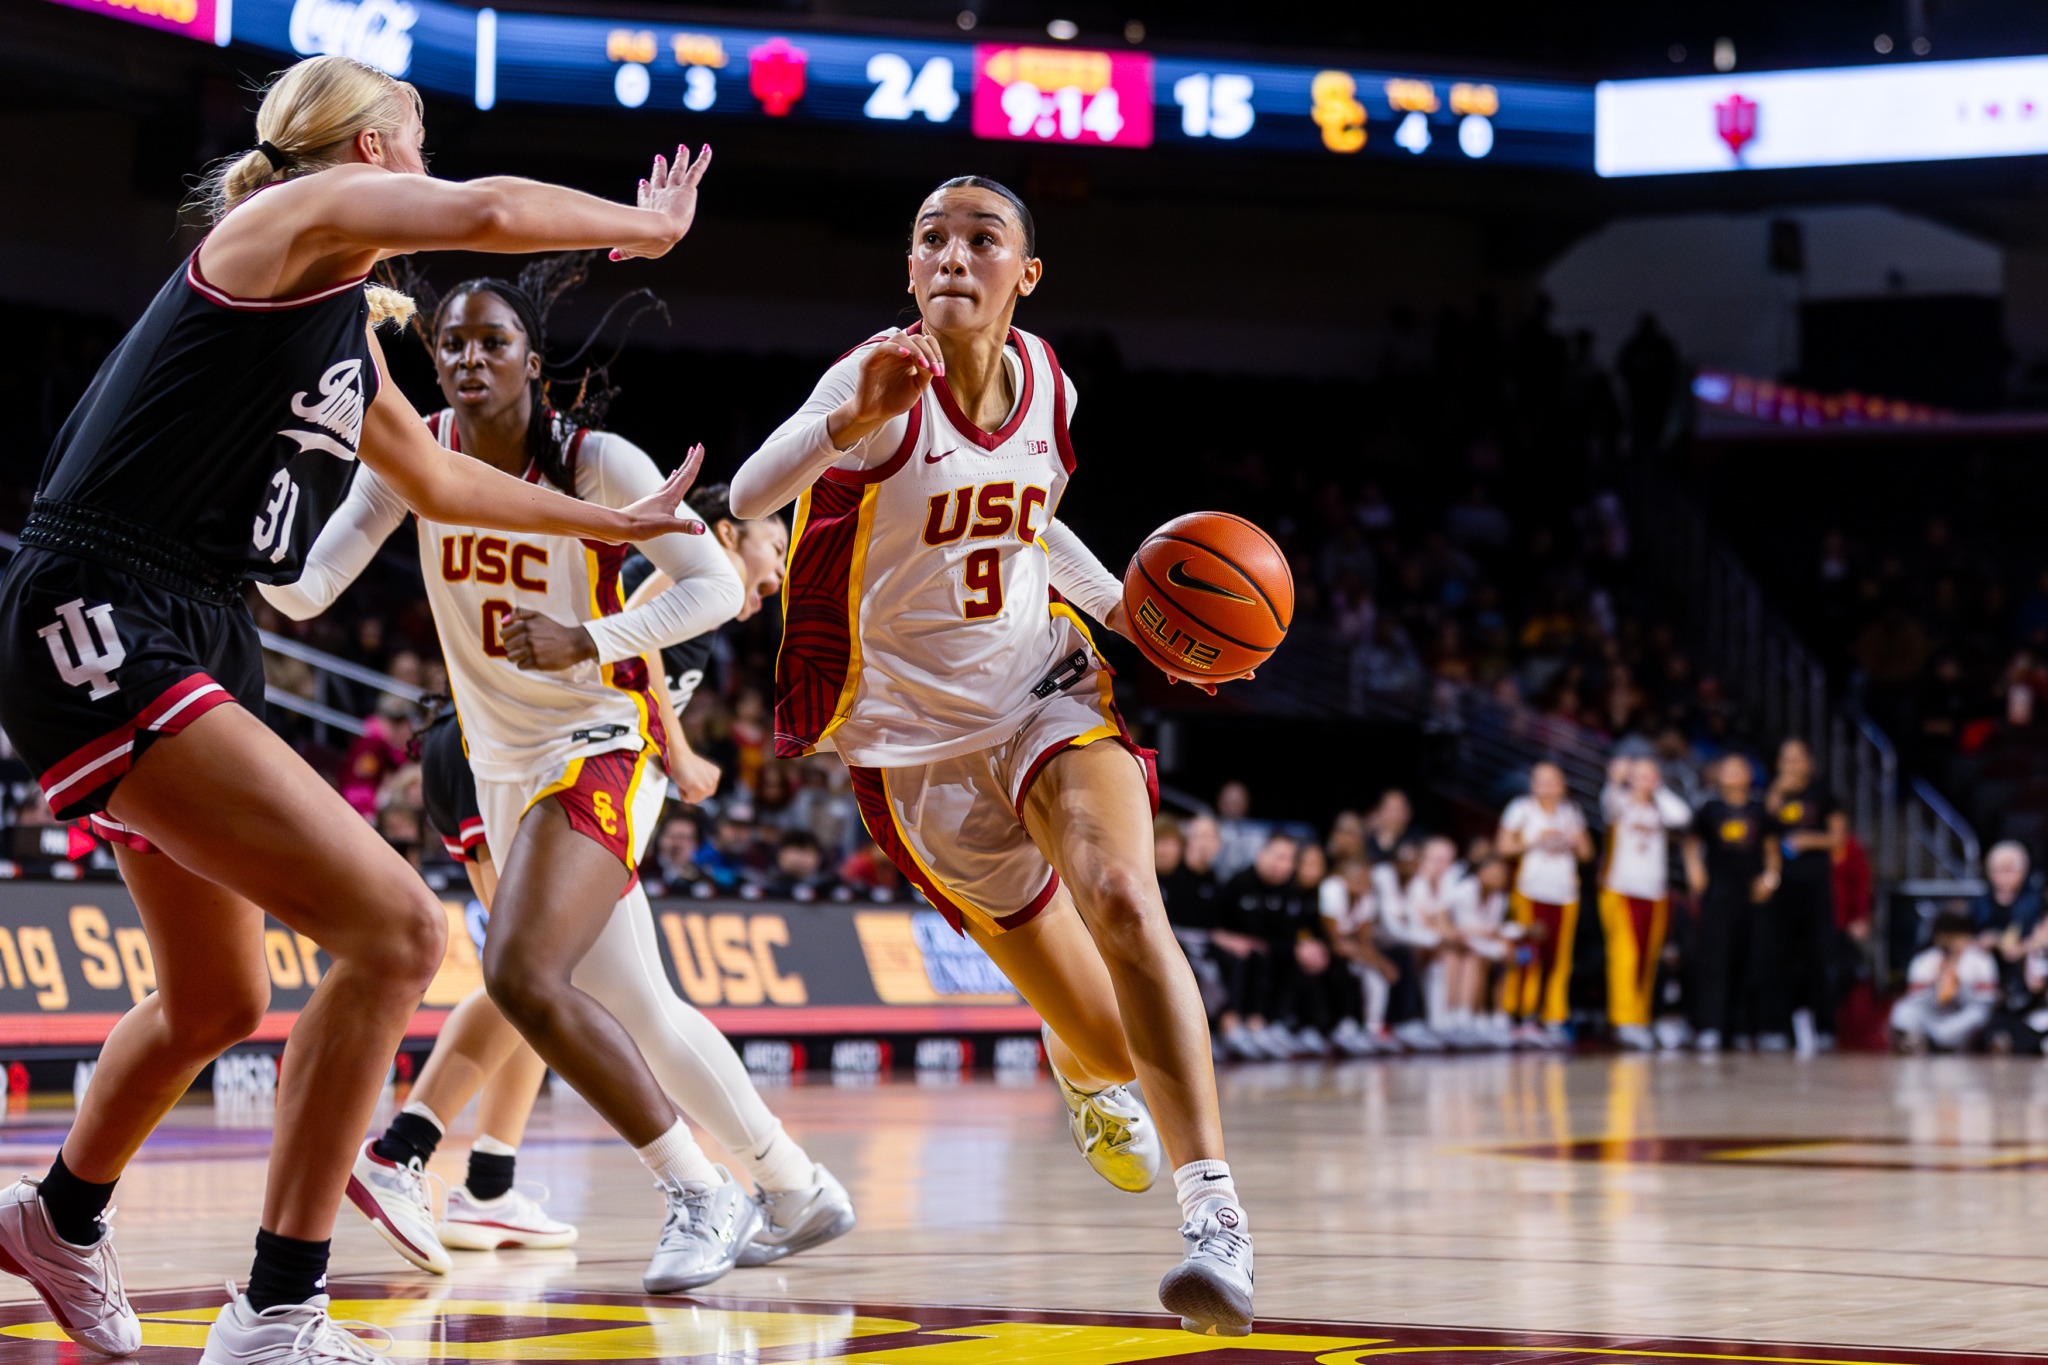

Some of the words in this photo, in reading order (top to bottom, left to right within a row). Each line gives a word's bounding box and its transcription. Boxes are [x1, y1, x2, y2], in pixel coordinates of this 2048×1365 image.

[615, 62, 650, 108] 0
[683, 65, 716, 111] 3
[865, 53, 959, 122] 24
[1001, 80, 1125, 142] 9:14
[1174, 72, 1255, 139] 15
[1394, 111, 1432, 154] 4
[1459, 114, 1493, 158] 0
[253, 467, 299, 563] 31
[922, 480, 1047, 547] USC
[441, 533, 548, 593] USC
[963, 548, 1004, 621] 9
[37, 598, 127, 701] IU
[1134, 614, 1211, 670] CHAMPIONSHIP
[1138, 596, 1223, 667] ELITE
[592, 790, 617, 836] SC
[660, 911, 808, 1005] USC
